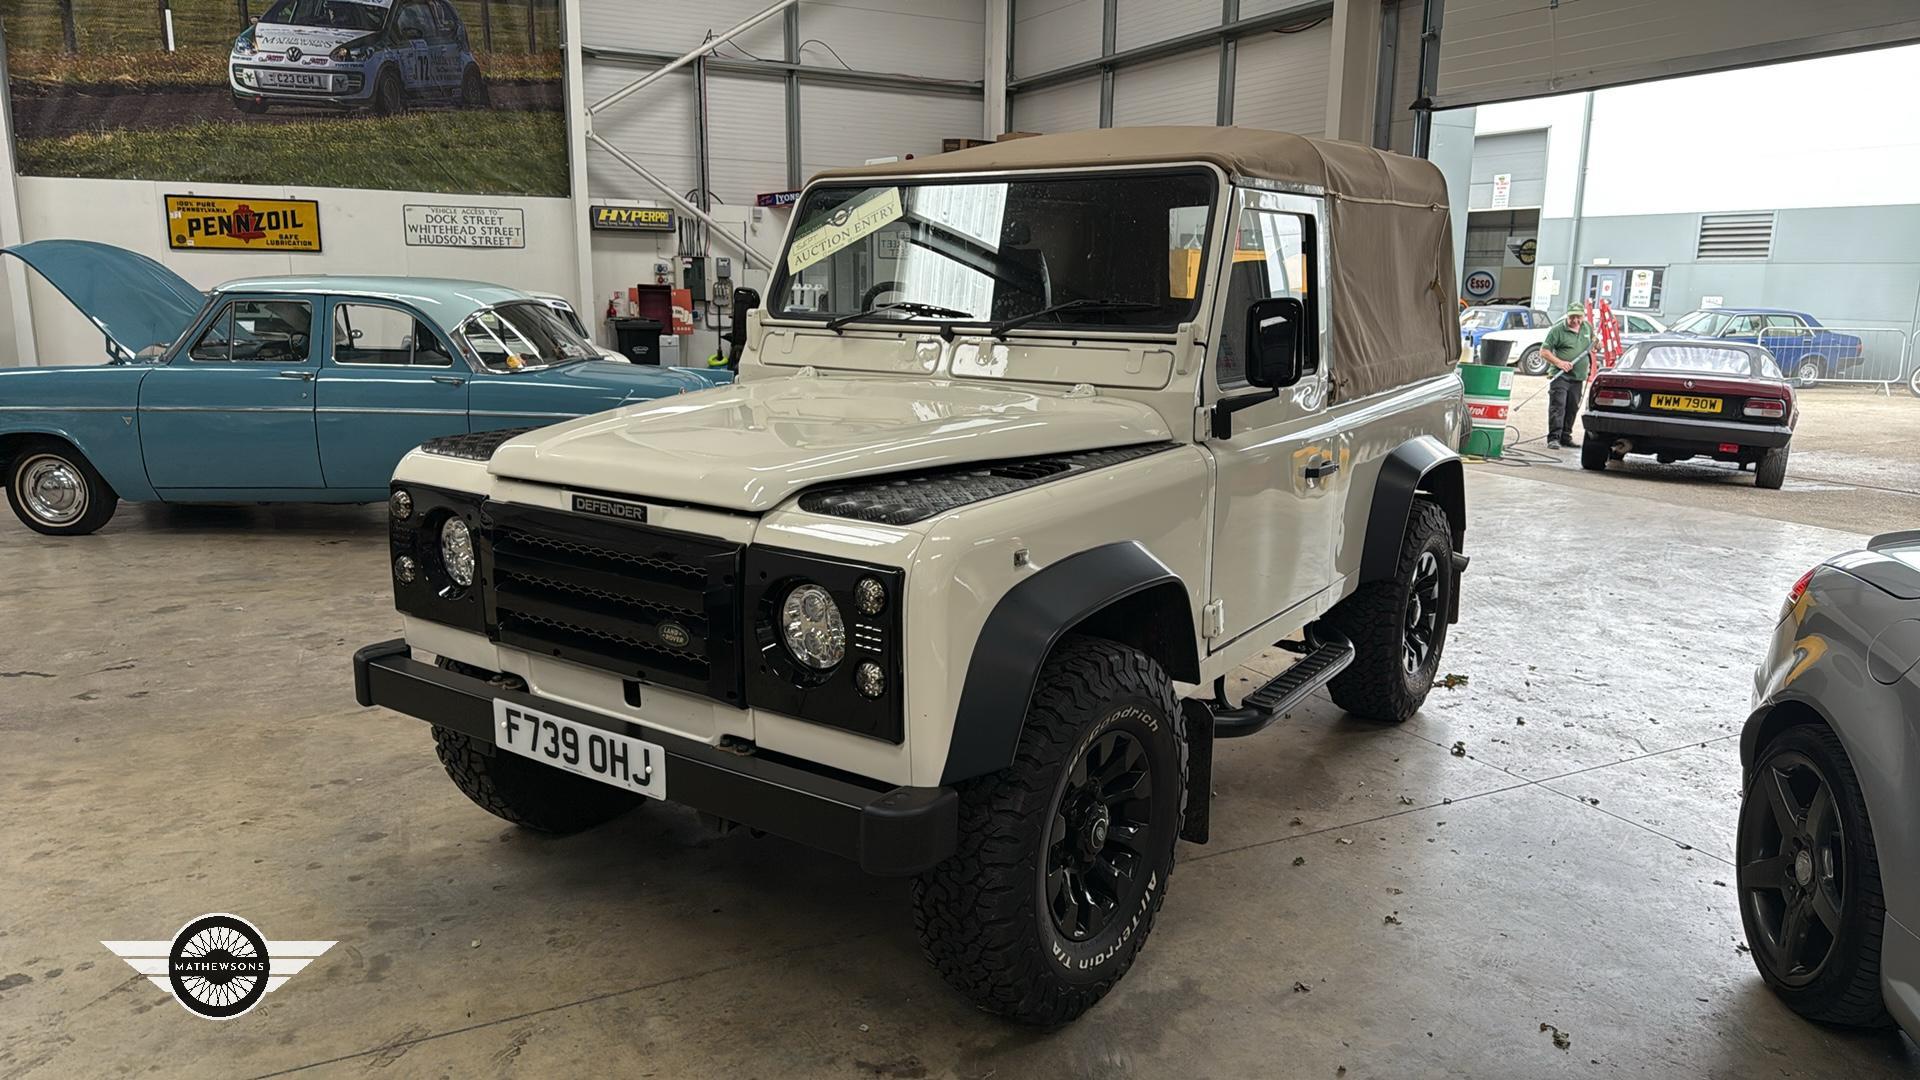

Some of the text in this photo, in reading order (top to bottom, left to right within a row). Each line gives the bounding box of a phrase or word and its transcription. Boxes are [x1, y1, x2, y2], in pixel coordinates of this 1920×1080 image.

[277, 73, 295, 83] C23
[187, 209, 304, 237] PENNZOIL
[425, 214, 504, 226] DOCK STREET
[408, 224, 521, 236] WHITEHEAD STREET
[794, 230, 850, 266] AUCTION
[854, 204, 896, 233] ENTRY
[419, 235, 512, 246] HUDSON STREET
[1656, 395, 1718, 410] WWM 790W
[1469, 406, 1485, 416] trol
[576, 498, 642, 519] DEFENDER
[505, 707, 651, 787] F739 OHJ
[1052, 869, 1157, 970] All-Terrain T/A
